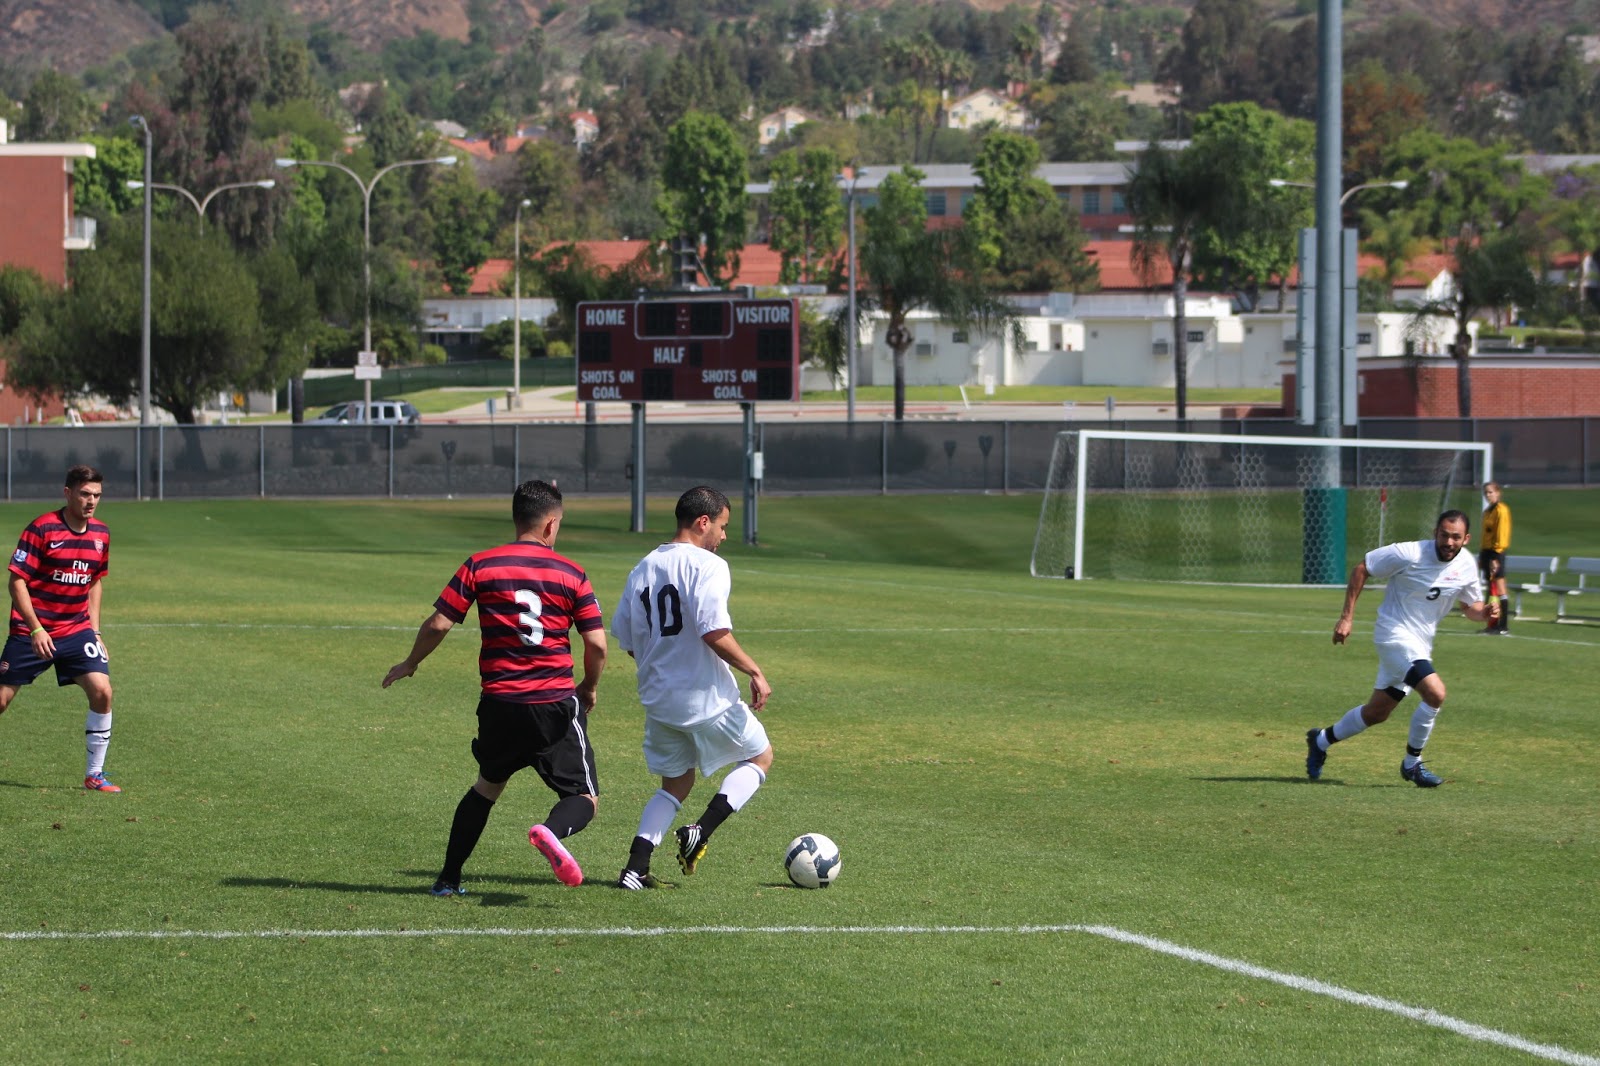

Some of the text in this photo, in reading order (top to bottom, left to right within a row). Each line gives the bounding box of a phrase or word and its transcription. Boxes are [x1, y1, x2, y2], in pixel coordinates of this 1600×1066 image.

[586, 309, 625, 325] HOME
[736, 306, 789, 323] VISITOR
[653, 347, 685, 363] HALF
[581, 370, 634, 384] SHOTS ON
[702, 370, 757, 383] SHOTS ON
[592, 386, 622, 399] GOAL
[714, 385, 744, 399] GOAL
[72, 560, 89, 572] Fly
[1426, 587, 1441, 600] 3
[514, 589, 544, 646] 3
[639, 584, 684, 638] 10
